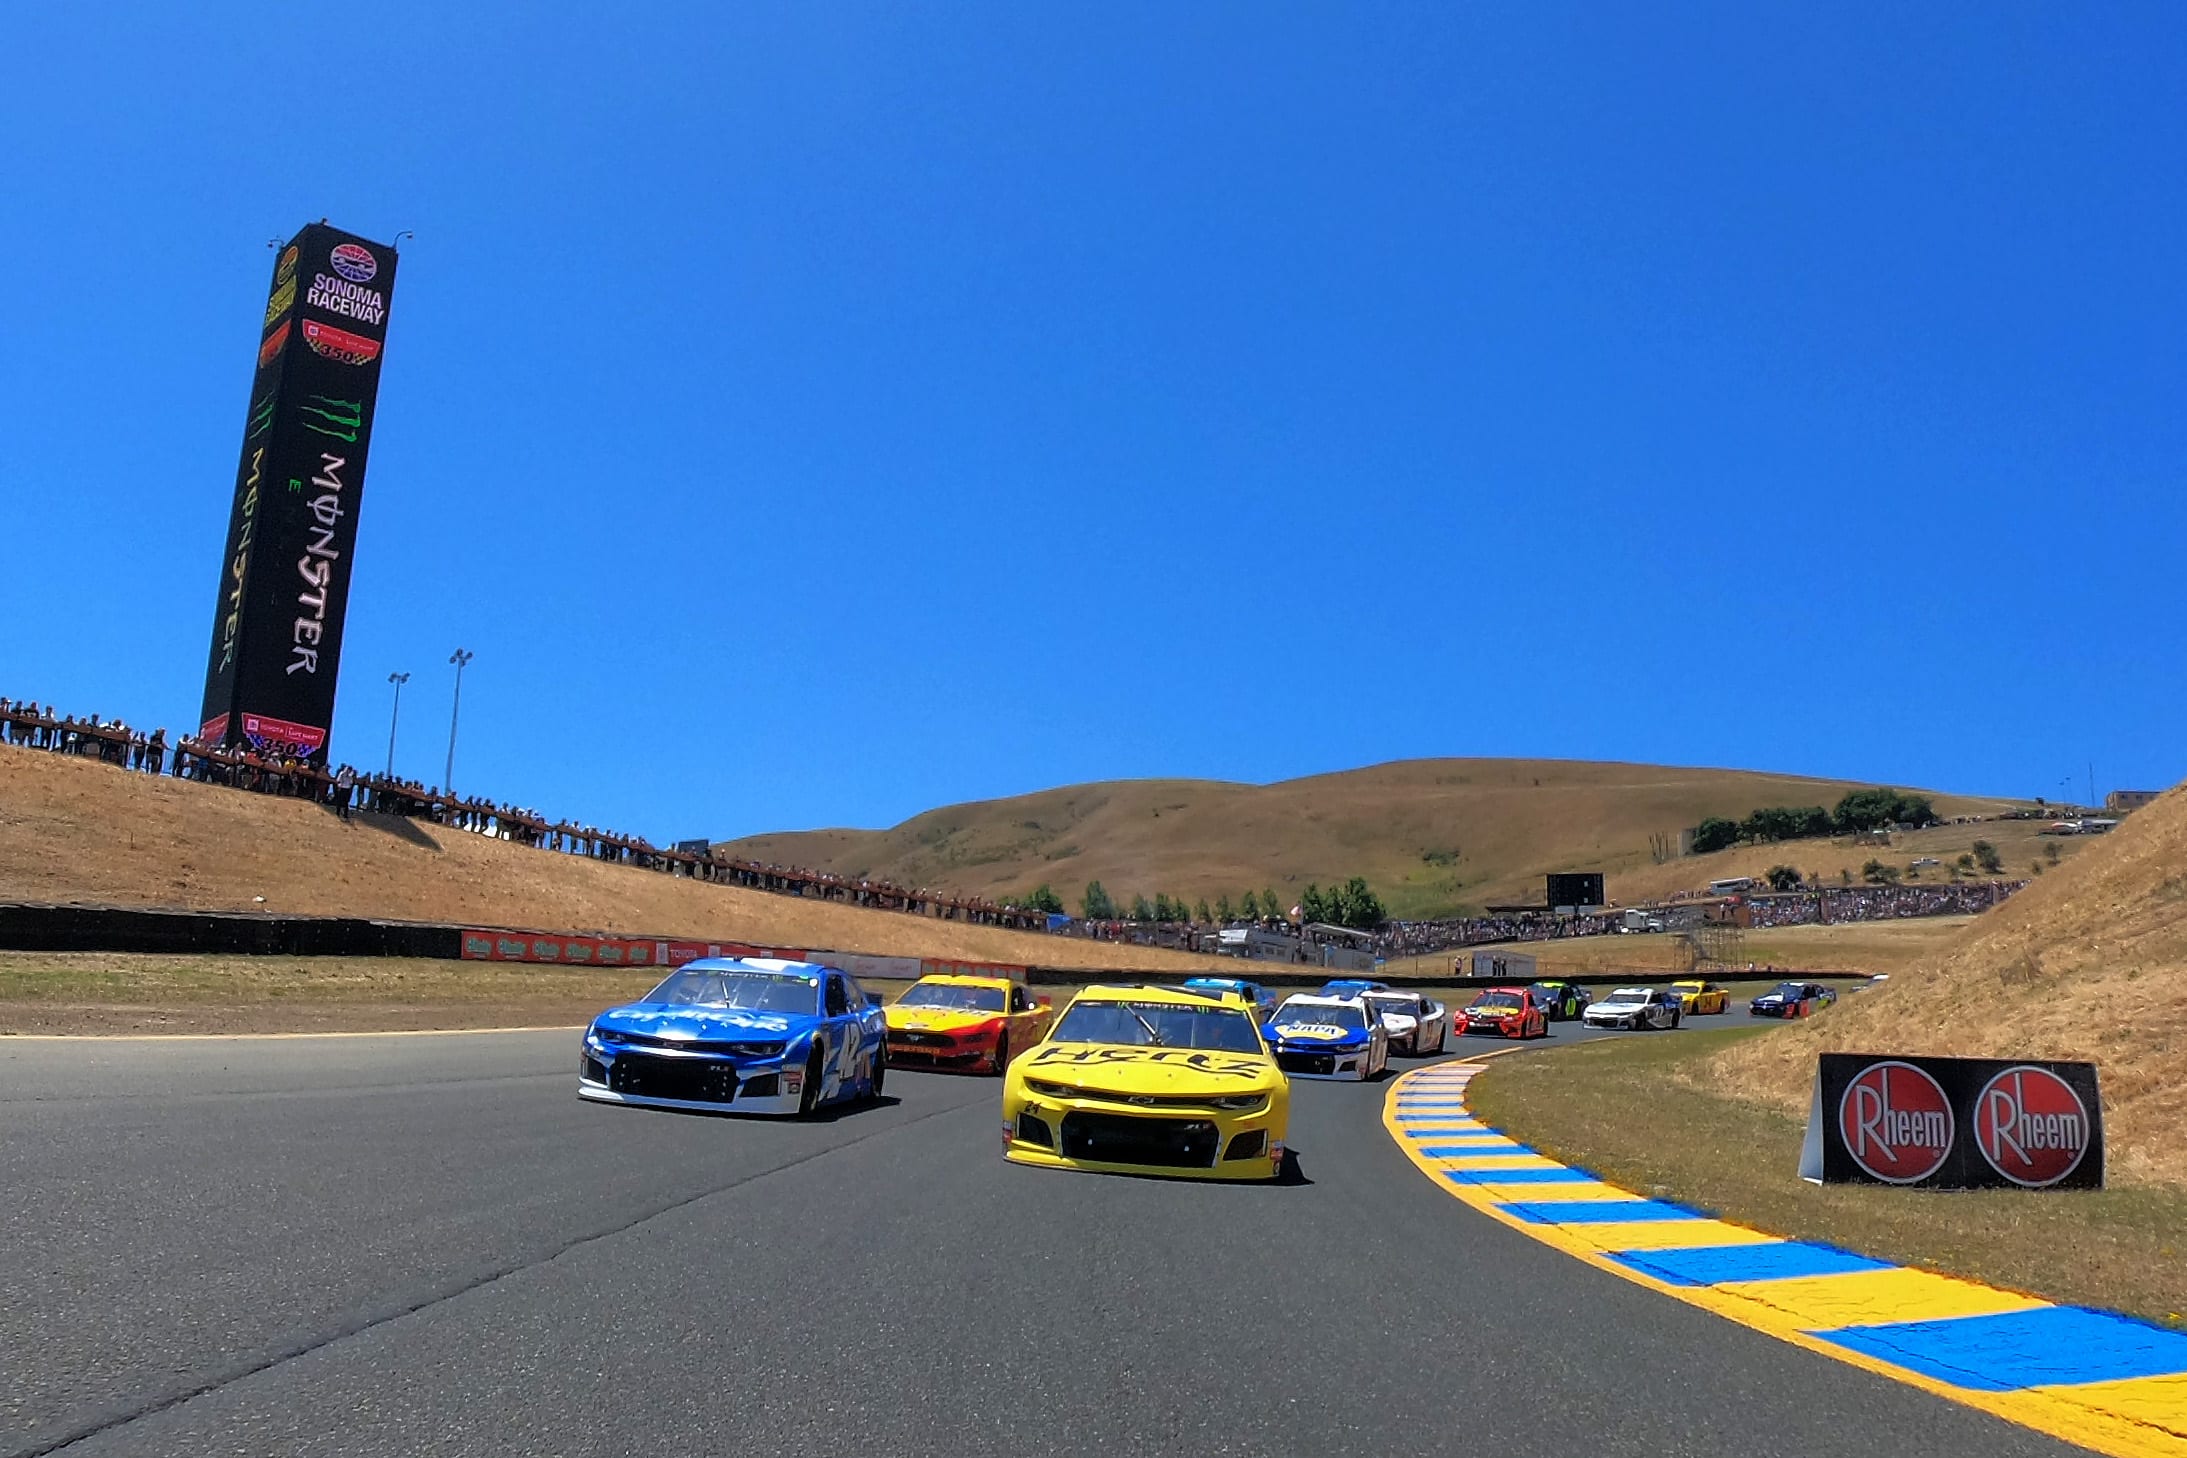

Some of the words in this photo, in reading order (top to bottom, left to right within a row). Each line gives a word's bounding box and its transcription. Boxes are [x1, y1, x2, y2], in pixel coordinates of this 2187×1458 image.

[306, 287, 385, 326] RACEWAY
[314, 272, 382, 310] SONOMA
[1287, 1024, 1338, 1035] NAPA
[1035, 1047, 1269, 1076] Hertz
[1856, 1068, 1946, 1163] Rheem
[1990, 1072, 2082, 1167] Rheem
